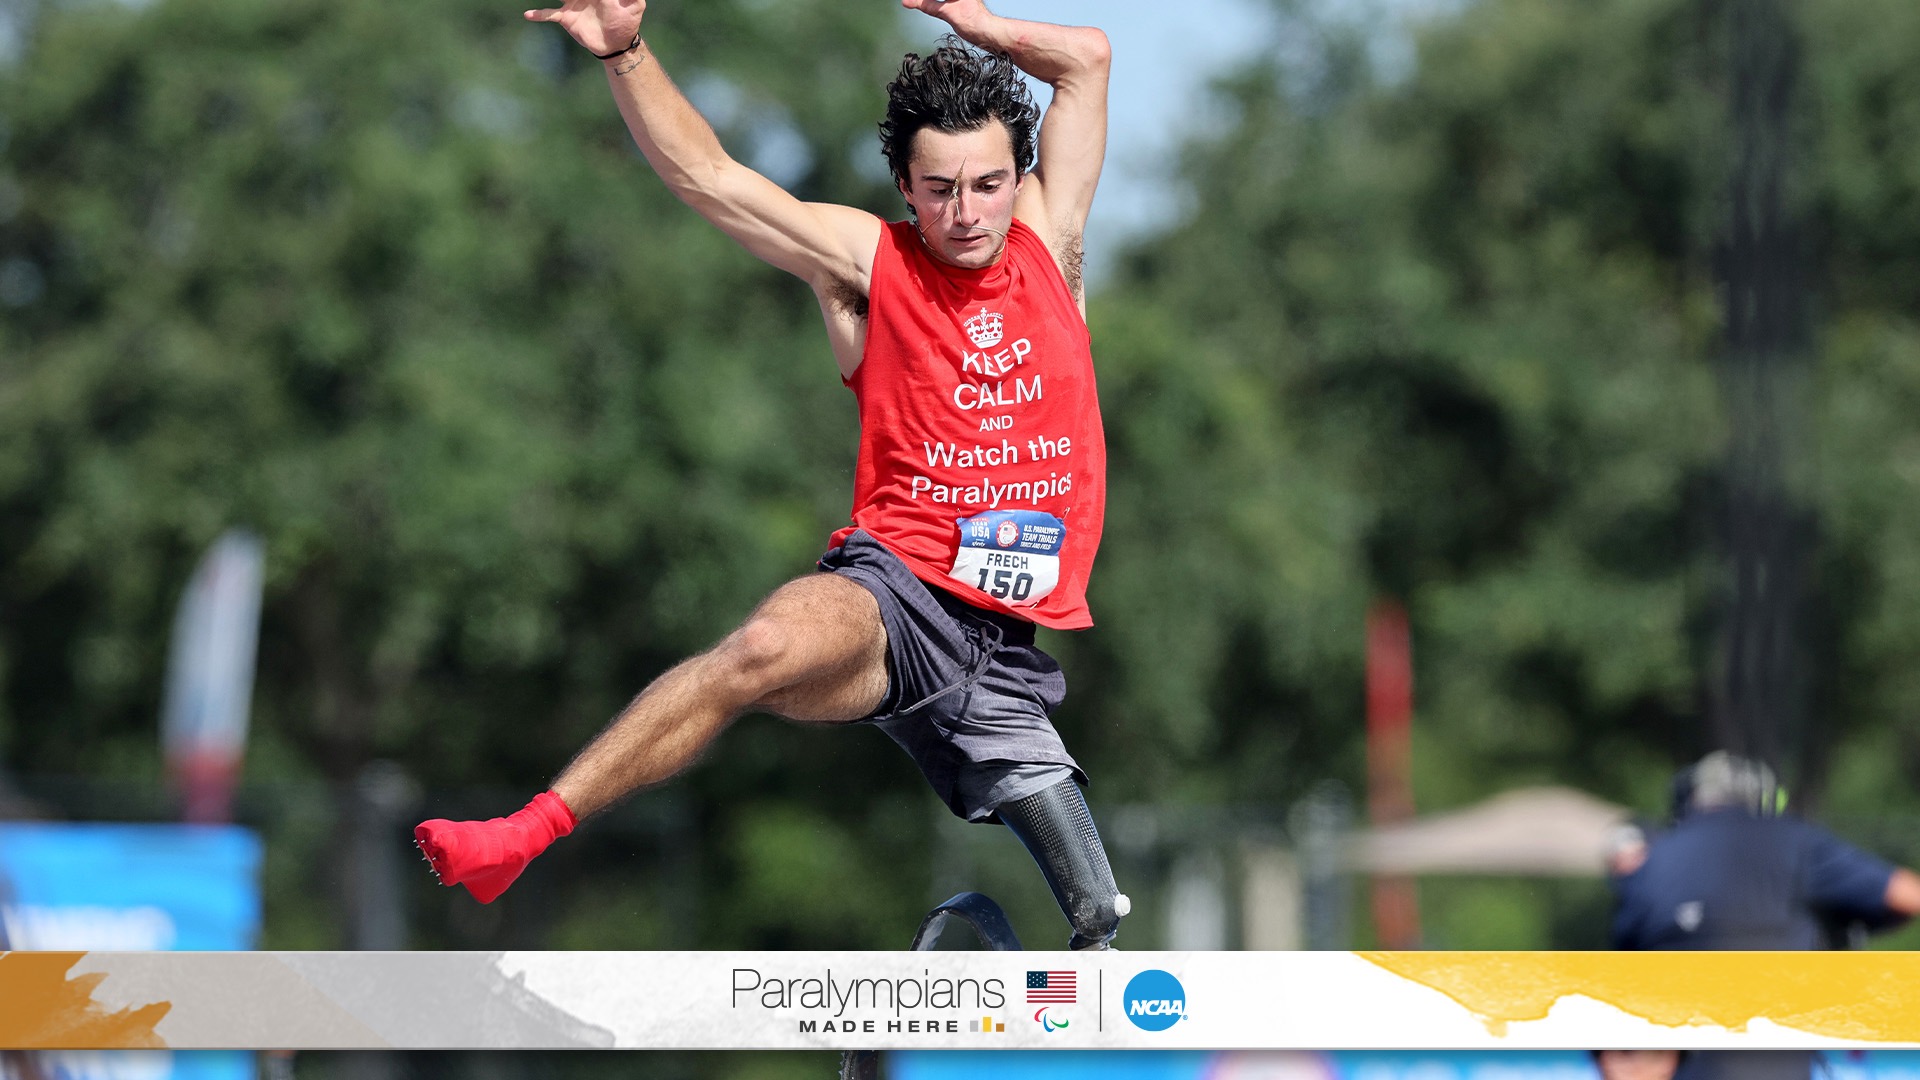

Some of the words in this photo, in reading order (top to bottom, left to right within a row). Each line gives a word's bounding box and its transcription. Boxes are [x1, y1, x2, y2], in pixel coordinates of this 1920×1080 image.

[962, 338, 1031, 376] KEEP
[954, 375, 1042, 410] CALM
[979, 415, 1014, 432] AND
[924, 439, 1018, 468] Watch
[1028, 435, 1071, 461] the
[911, 472, 1072, 509] Paralympics
[971, 526, 990, 540] USA
[1022, 532, 1038, 541] TEAM
[1038, 533, 1058, 544] TRIALS
[986, 553, 1028, 569] FRECH
[977, 568, 1034, 601] 150
